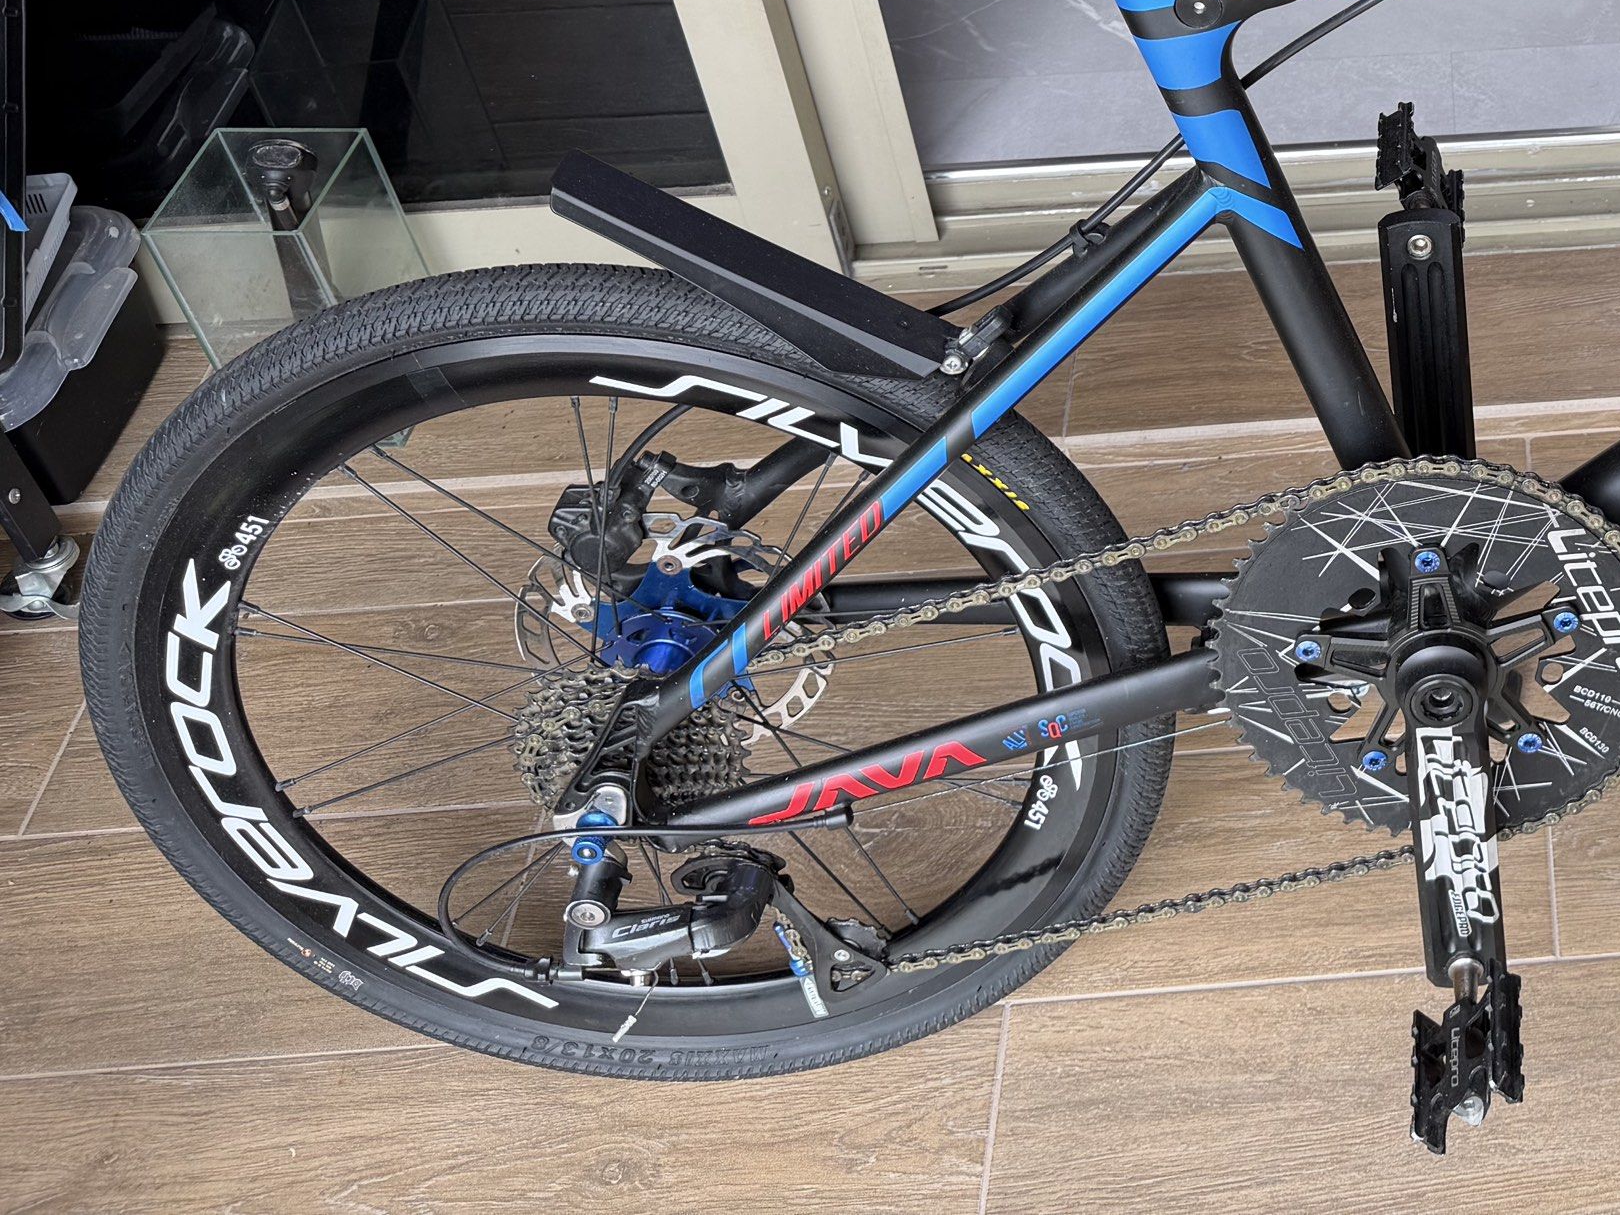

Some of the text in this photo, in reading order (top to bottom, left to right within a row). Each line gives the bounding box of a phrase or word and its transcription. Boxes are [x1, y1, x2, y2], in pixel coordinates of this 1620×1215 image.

[235, 515, 270, 546] 451
[762, 500, 883, 642] LIMITED
[1573, 685, 1612, 705] BCD110
[1578, 726, 1610, 755] BCD130
[748, 740, 989, 826] JAVA
[1022, 801, 1050, 832] 451
[611, 914, 681, 940] Claris
[1450, 1027, 1461, 1088] Litepro
